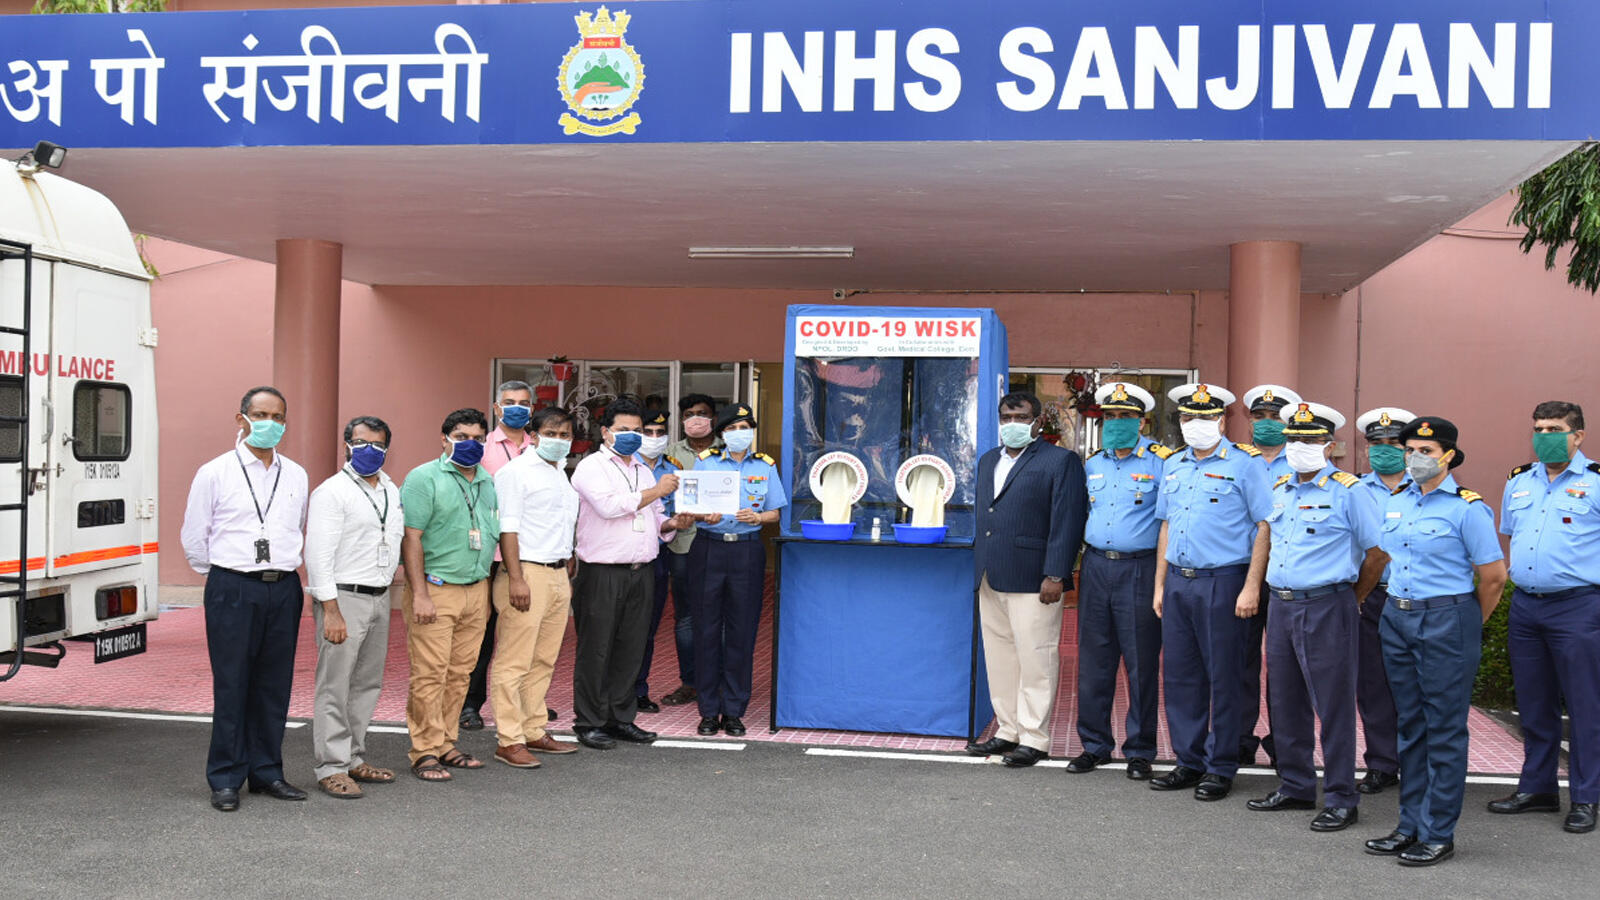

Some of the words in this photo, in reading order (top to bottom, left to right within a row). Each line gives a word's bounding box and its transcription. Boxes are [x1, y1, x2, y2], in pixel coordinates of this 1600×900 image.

[0, 60, 69, 127] अ
[90, 28, 166, 126] पो
[200, 23, 489, 125] संजीवनी
[730, 28, 961, 112] INHS
[997, 23, 1552, 111] SANJIVANI
[800, 320, 907, 337] COVID-19
[914, 320, 977, 337] WISK
